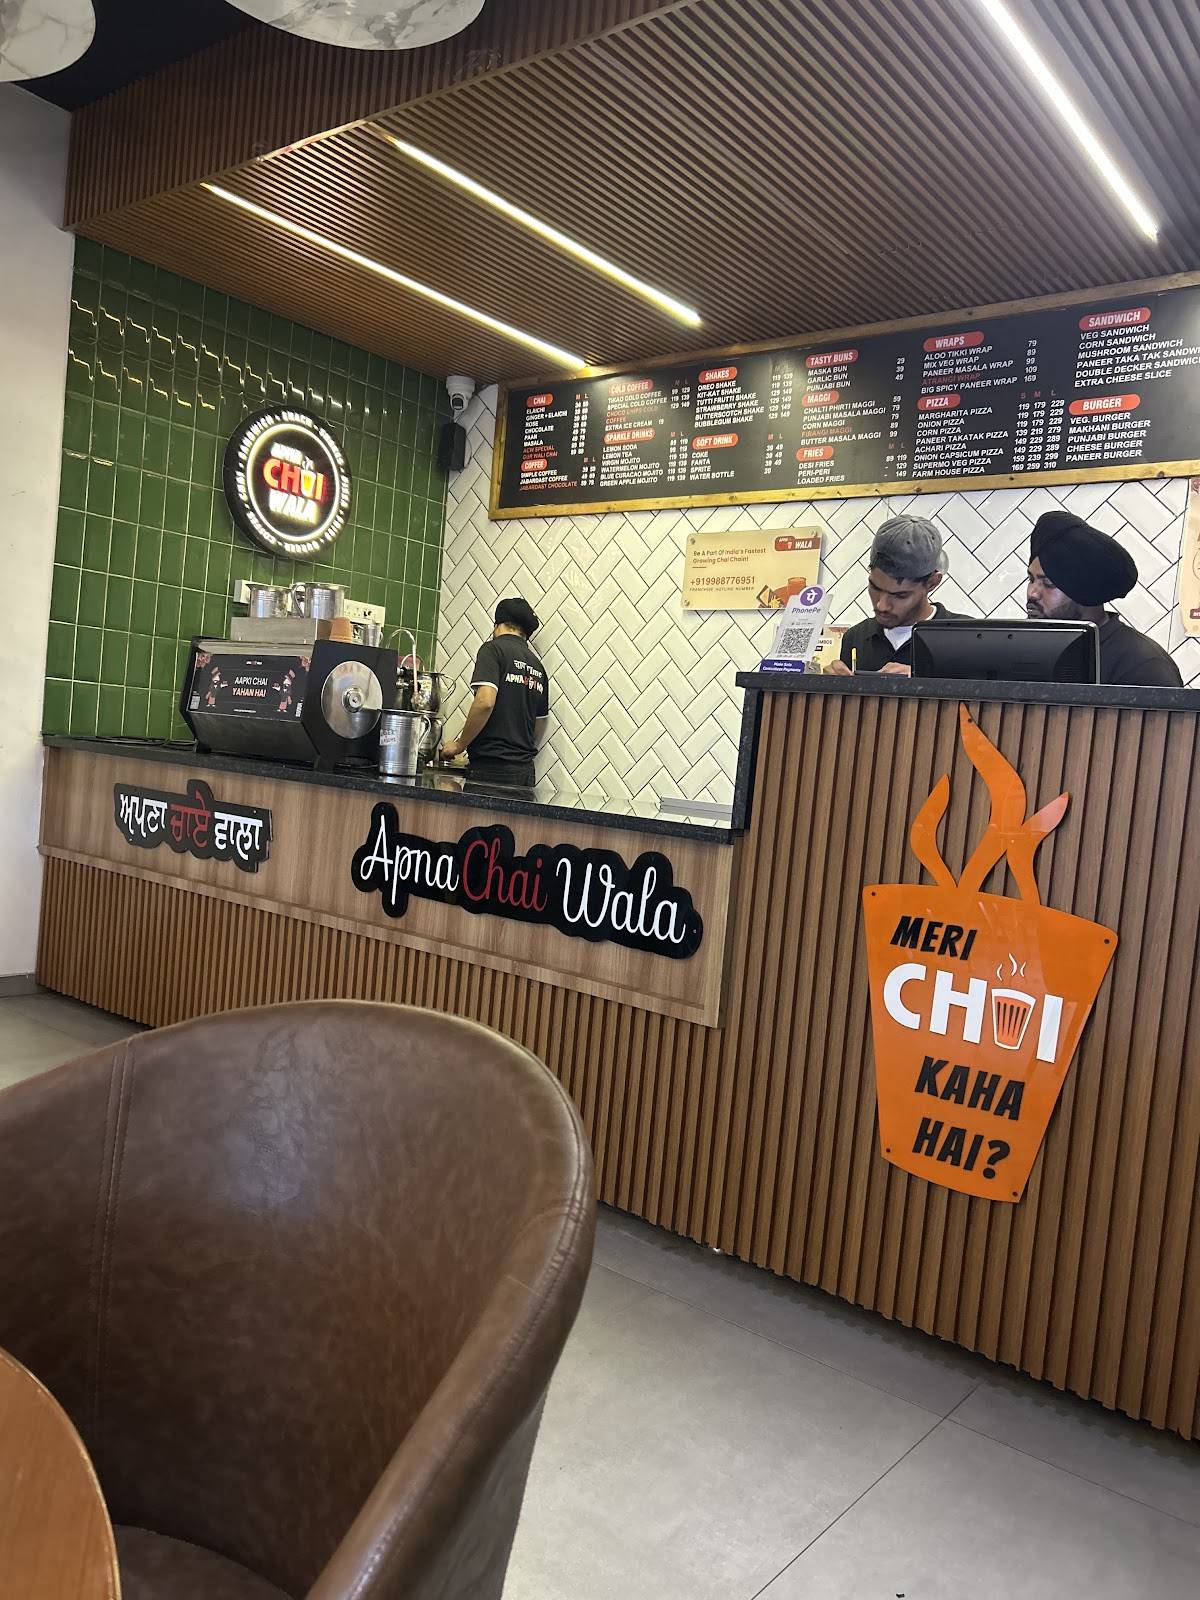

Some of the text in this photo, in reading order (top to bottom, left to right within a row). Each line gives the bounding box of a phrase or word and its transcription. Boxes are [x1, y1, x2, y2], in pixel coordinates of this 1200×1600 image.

[1089, 311, 1141, 327] SANDWICH
[1081, 325, 1149, 340] VEG SANDWICH
[936, 337, 965, 348] WRAPS
[1079, 333, 1156, 349] CORN SANDWICH
[969, 346, 993, 354] WRAP
[1078, 339, 1183, 359] MUSHROOM SANDWICH
[810, 352, 853, 366] TASTY BUNS
[956, 356, 979, 365] WRAP
[1077, 359, 1112, 368] PANEER
[1115, 355, 1139, 364] TAKA
[705, 370, 729, 380] SHAKES
[1076, 368, 1112, 378] DOUBLE
[1114, 363, 1152, 373] DECKER
[960, 380, 991, 390] PANEER
[994, 377, 1018, 386] WRAP
[1074, 370, 1172, 387] EXTRA CHEESE SLICE
[627, 382, 649, 391] COFFEE
[807, 383, 835, 391] PUNJABI
[808, 394, 831, 402] MAGGI
[926, 398, 949, 408] PIZZA
[1083, 398, 1122, 410] BURGER
[696, 403, 737, 413] STRAWBERRY
[919, 407, 993, 420] MARGHARITA PIZZA
[803, 414, 831, 422] PUNJABI
[833, 410, 861, 418] MASALA
[1092, 413, 1131, 423] BURGER
[525, 425, 554, 434] CHOCOLATE
[1069, 420, 1151, 434] MAKHANI BURGER
[829, 435, 856, 443] MASALA
[916, 436, 946, 445] PANEER
[948, 433, 984, 442] TAKATAK
[1068, 430, 1147, 443] PUNJABI BURGER
[915, 445, 944, 453] ACHARI
[1067, 440, 1143, 452] CHEESE BURGER
[803, 449, 824, 458] FRIES
[940, 450, 980, 459] CAPSICUM
[1066, 450, 1142, 462] PANEER BURGER
[913, 461, 950, 470] SUPERMO
[798, 469, 830, 477] PERI-PERI
[795, 540, 812, 548] WALA
[690, 576, 755, 585] +919988776951
[234, 677, 268, 686] AAPKI CHAI
[232, 688, 254, 696] YAHAN
[214, 812, 263, 860] ਵਾਲਾ
[360, 814, 686, 944] Apna Chai Wala
[890, 915, 977, 960] MERI
[914, 1056, 1025, 1121] KAHA
[912, 1117, 1011, 1179] HAI?
